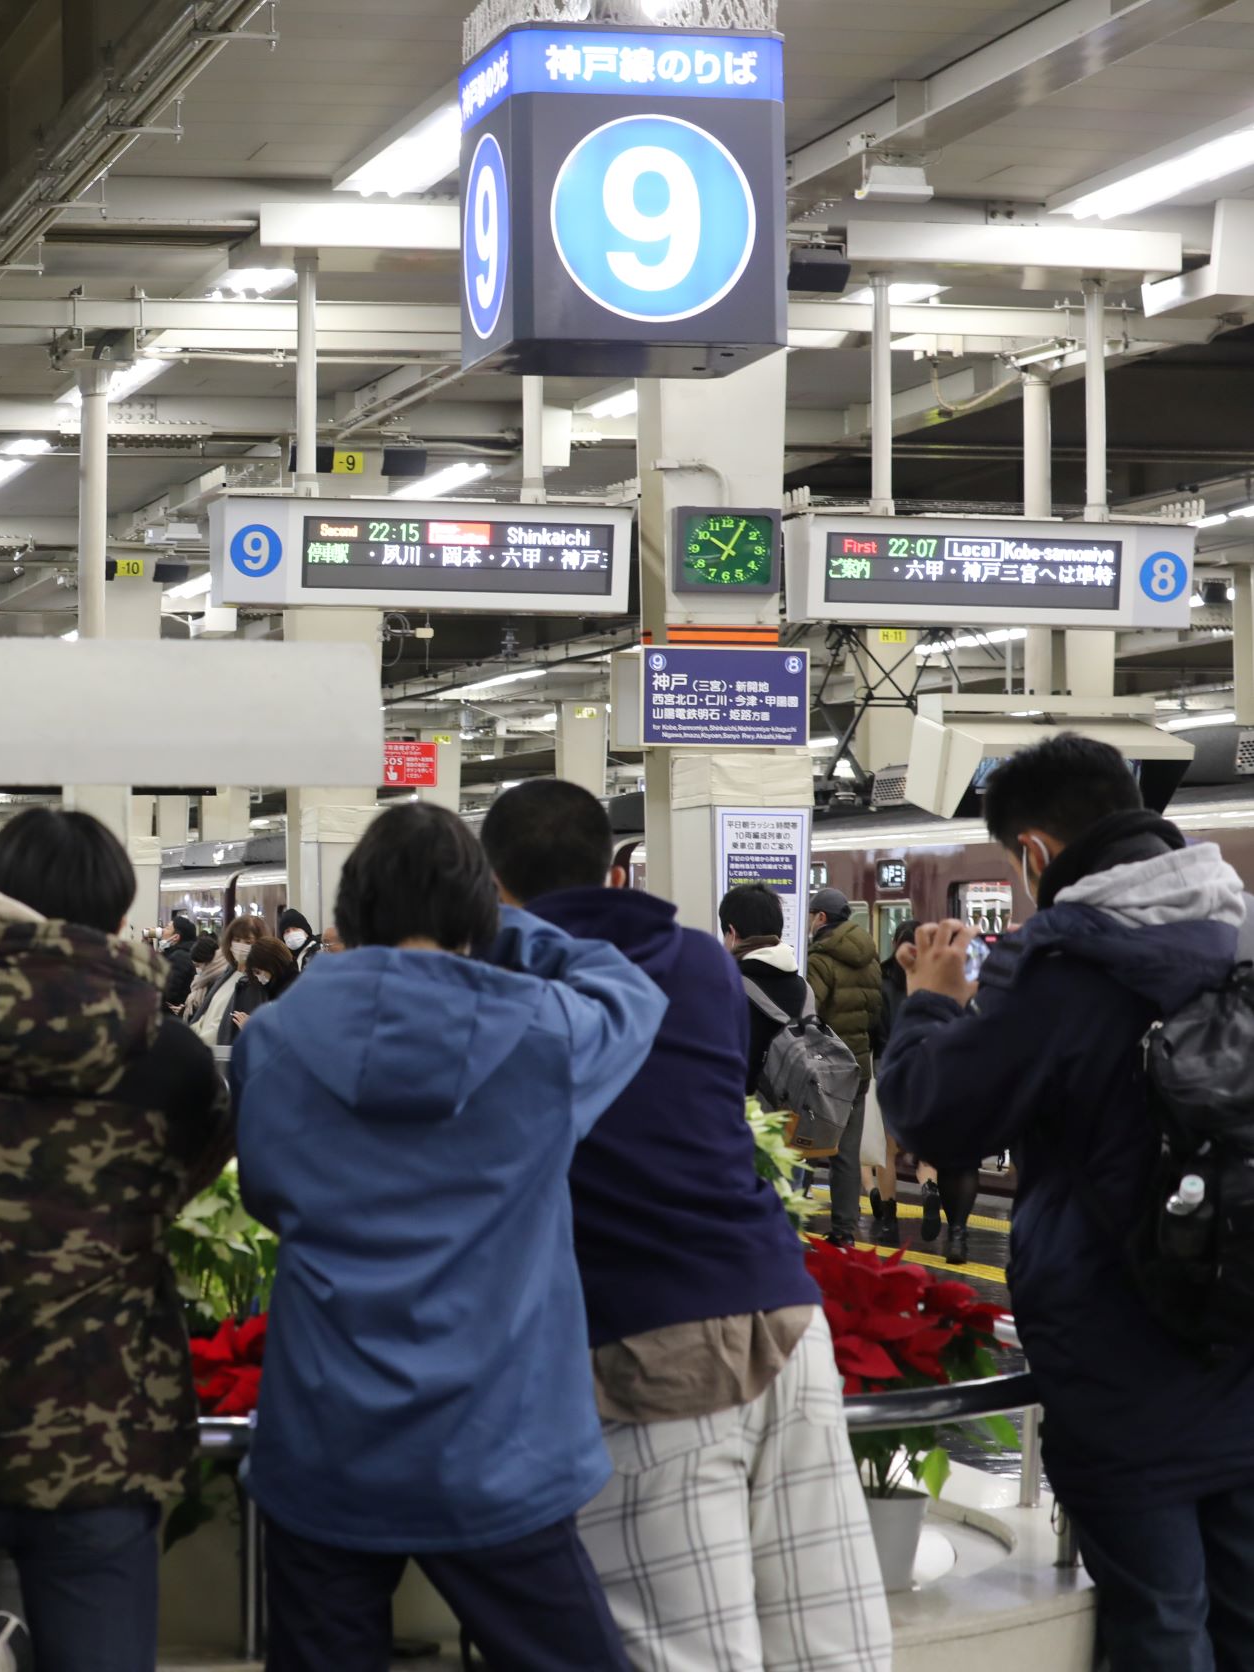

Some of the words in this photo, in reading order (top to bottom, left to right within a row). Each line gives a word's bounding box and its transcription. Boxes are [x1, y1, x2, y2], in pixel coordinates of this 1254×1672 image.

[545, 44, 758, 85] 神戸線のりば
[602, 145, 702, 292] 9
[474, 165, 498, 309] 9
[338, 455, 356, 471] -9
[709, 522, 720, 531] 11
[722, 519, 734, 528] 12
[320, 523, 358, 538] Second
[368, 522, 420, 542] 22:15
[507, 526, 591, 546] Shinkaichi
[698, 531, 710, 540] 10
[748, 531, 757, 540] 2
[242, 530, 272, 571] 9
[691, 544, 700, 553] 9
[754, 546, 763, 555] 3
[843, 538, 878, 554] First
[888, 538, 937, 558] 22:07
[952, 542, 997, 558] Local
[121, 562, 140, 574] -10
[697, 559, 706, 568] 8
[747, 560, 756, 569] 4
[829, 558, 871, 579] ご案内
[709, 568, 717, 577] 7
[721, 571, 730, 581] 6
[735, 569, 744, 578] 5
[1150, 558, 1176, 596] 8
[653, 655, 663, 669] 9
[788, 658, 799, 672] 8
[652, 673, 688, 691] 神戸
